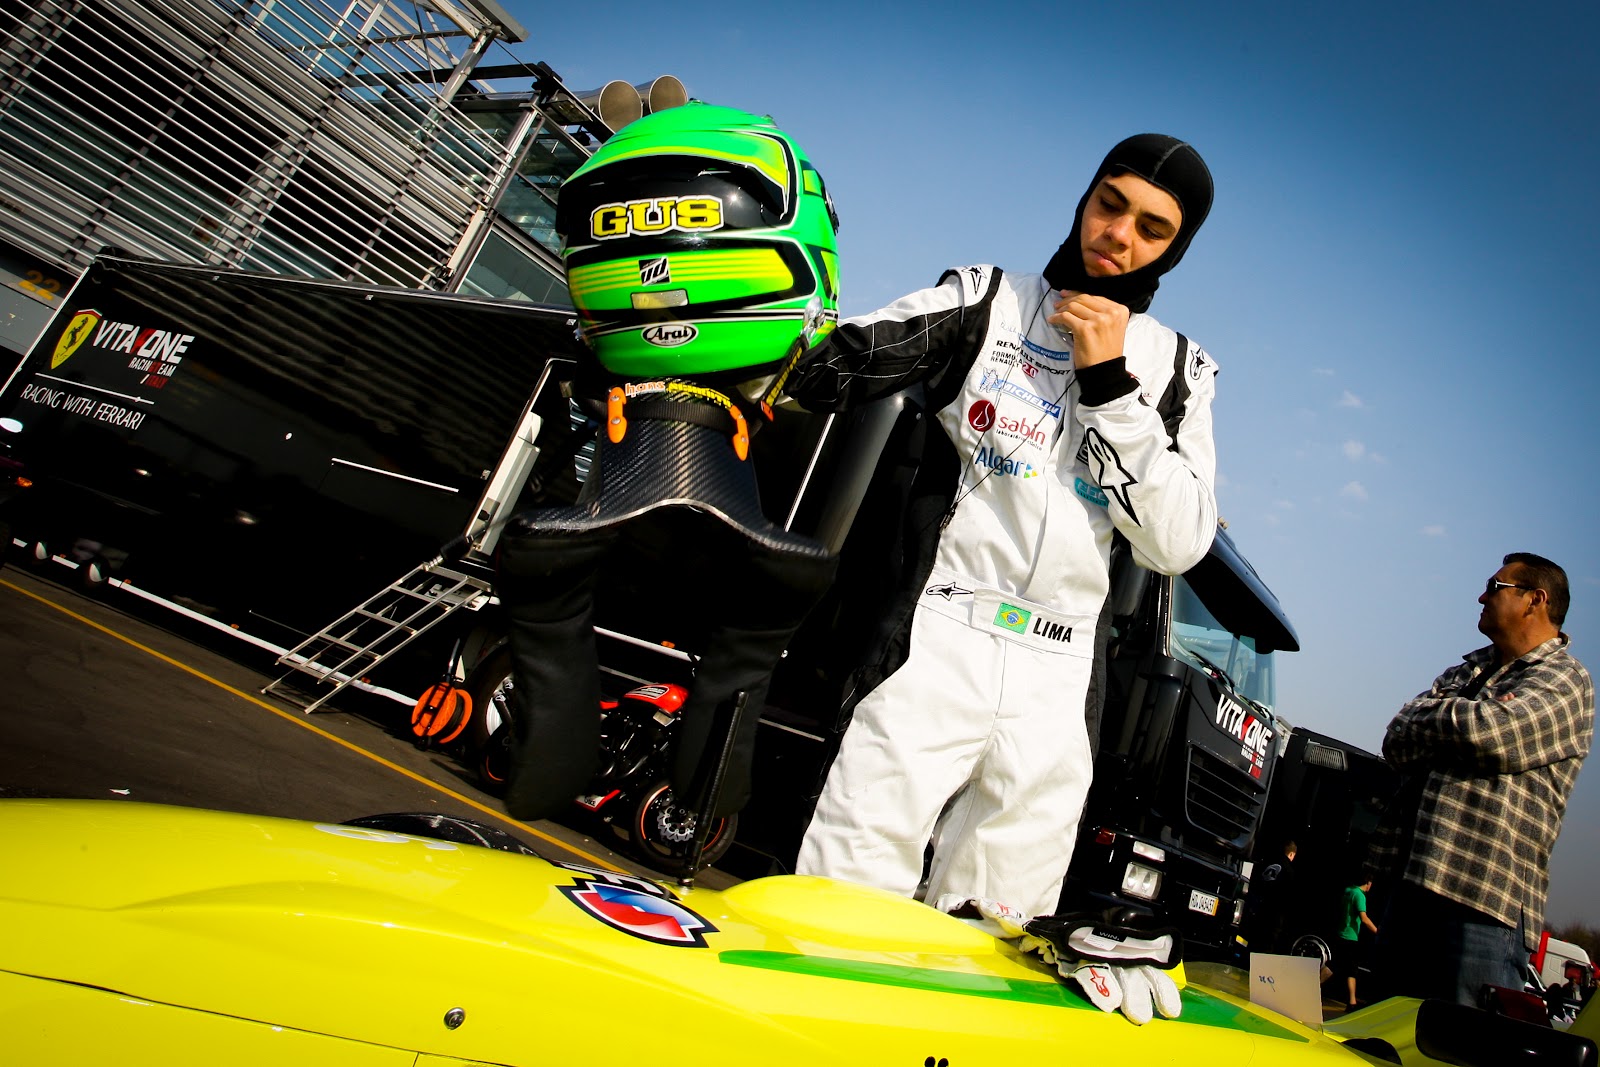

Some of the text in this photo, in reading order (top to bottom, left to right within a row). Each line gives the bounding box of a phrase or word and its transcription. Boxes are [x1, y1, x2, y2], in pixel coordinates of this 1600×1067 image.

[590, 195, 724, 240] GUS
[647, 326, 691, 341] Arai
[990, 356, 1020, 368] RENAULT
[992, 350, 1023, 365] FORMULA
[1034, 361, 1071, 376] SPORT
[625, 381, 666, 398] hans
[998, 379, 1060, 414] MICHELIN
[20, 383, 146, 430] RACING WITH FERRARI
[997, 415, 1046, 445] sabin
[975, 447, 1024, 477] Algar
[1032, 617, 1073, 643] LIMA
